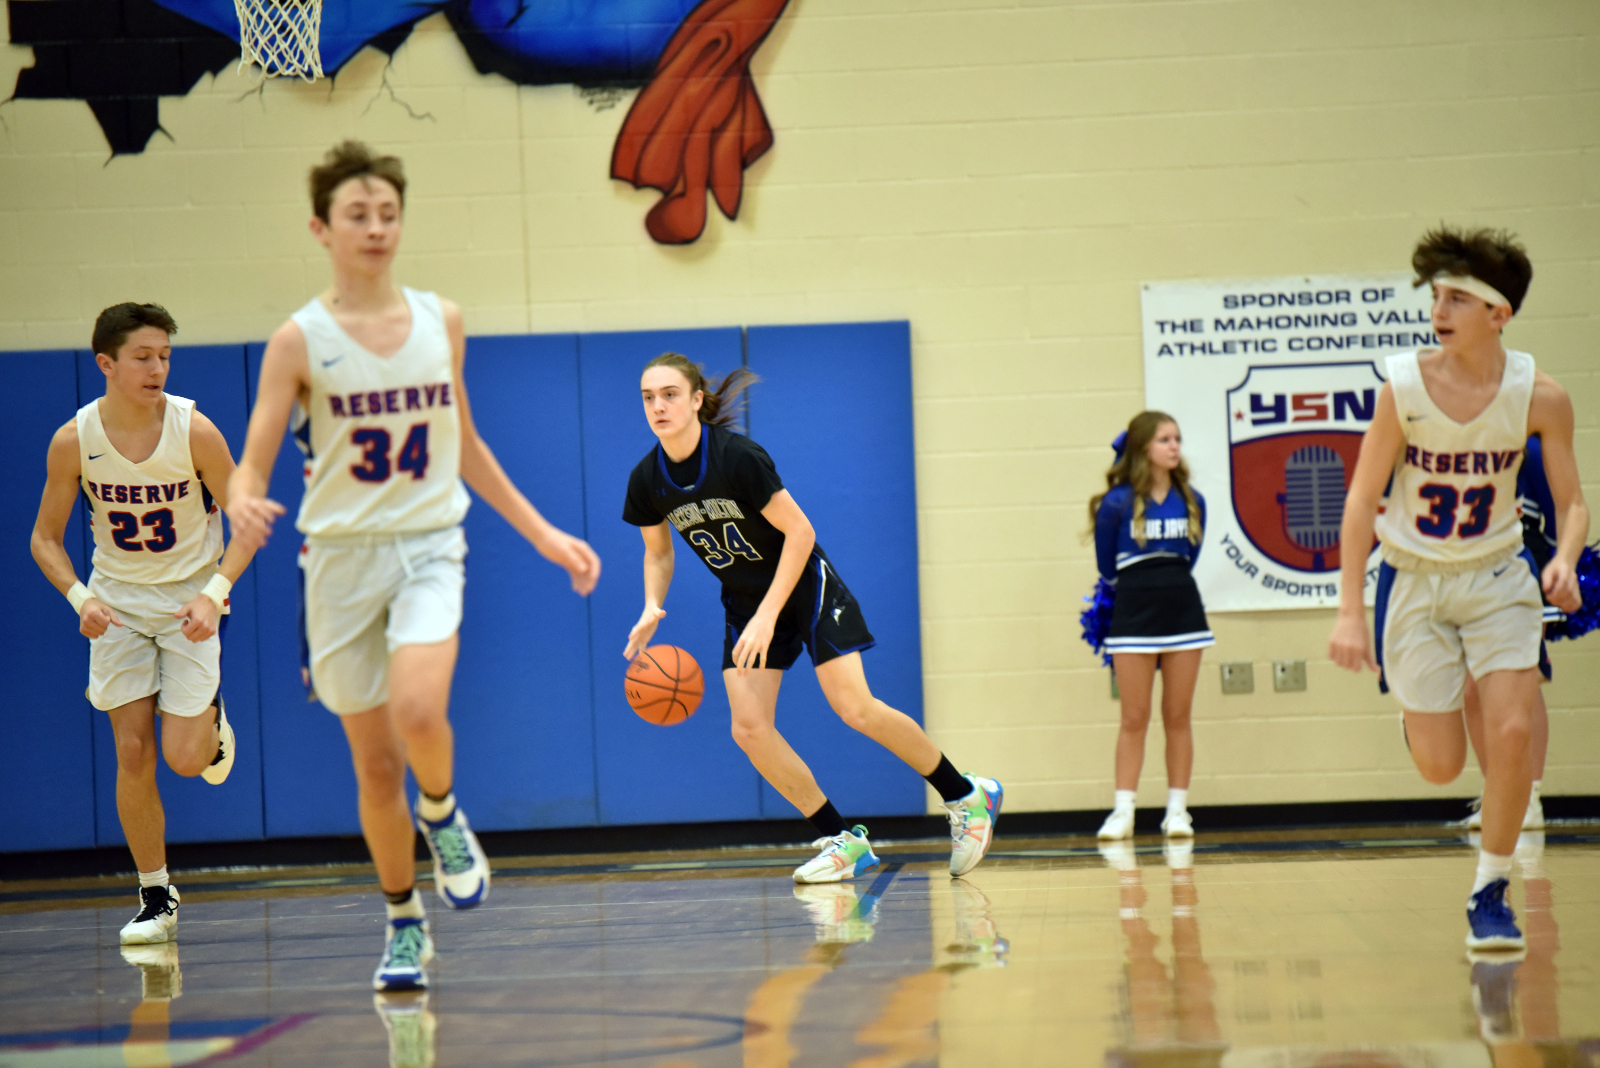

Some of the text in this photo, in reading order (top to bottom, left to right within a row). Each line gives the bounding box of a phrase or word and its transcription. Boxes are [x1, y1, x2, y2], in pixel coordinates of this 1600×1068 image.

[1223, 288, 1395, 309] SPONSOR OF
[1155, 309, 1431, 334] THE MAHONING VALL
[1157, 331, 1442, 357] ATHLETIC CONFEREN
[328, 383, 451, 418] RESERVE
[1249, 388, 1376, 426] YSN
[350, 421, 429, 483] 34
[87, 479, 190, 504] RESERVE
[1416, 481, 1497, 540] 33
[107, 507, 177, 553] 23
[689, 521, 763, 569] 34
[1219, 533, 1259, 579] YOUR
[1261, 573, 1338, 598] SPORTS
